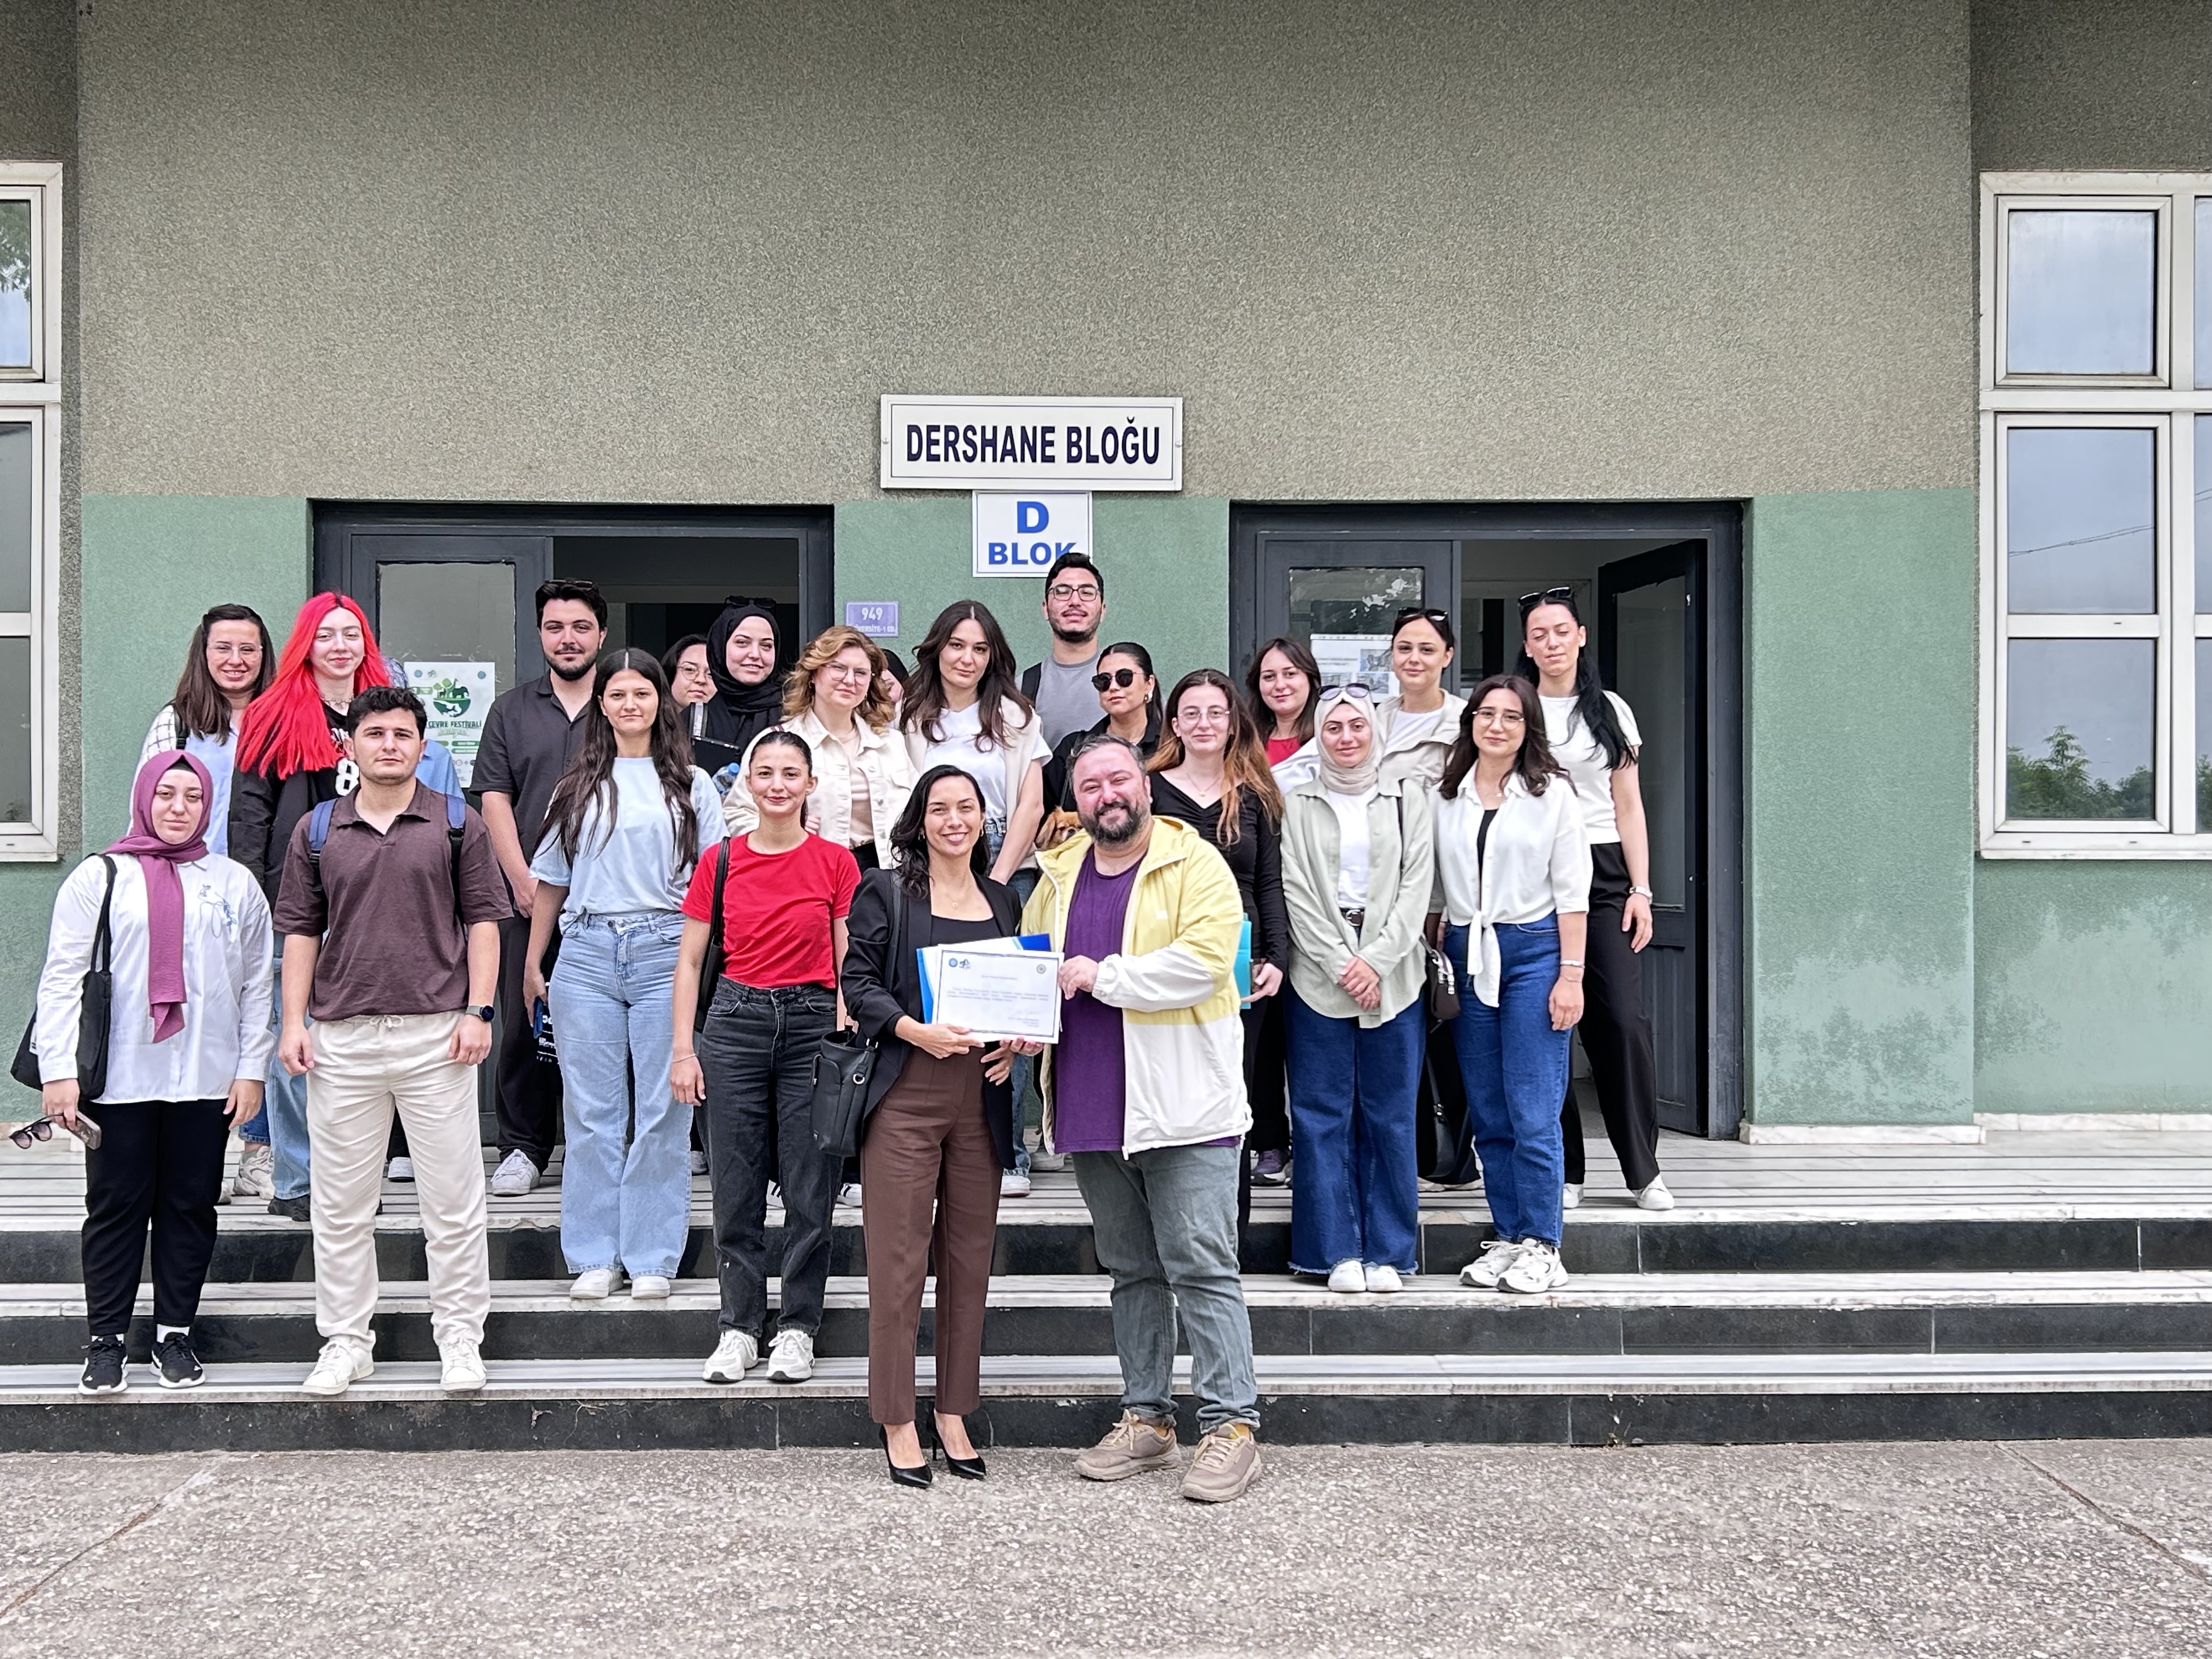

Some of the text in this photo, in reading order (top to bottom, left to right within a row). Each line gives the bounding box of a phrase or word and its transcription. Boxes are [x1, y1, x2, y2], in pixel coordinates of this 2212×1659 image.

[906, 415, 1160, 465] DERSHANE BLOĞU
[1017, 501, 1049, 534] D
[861, 607, 883, 620] 949
